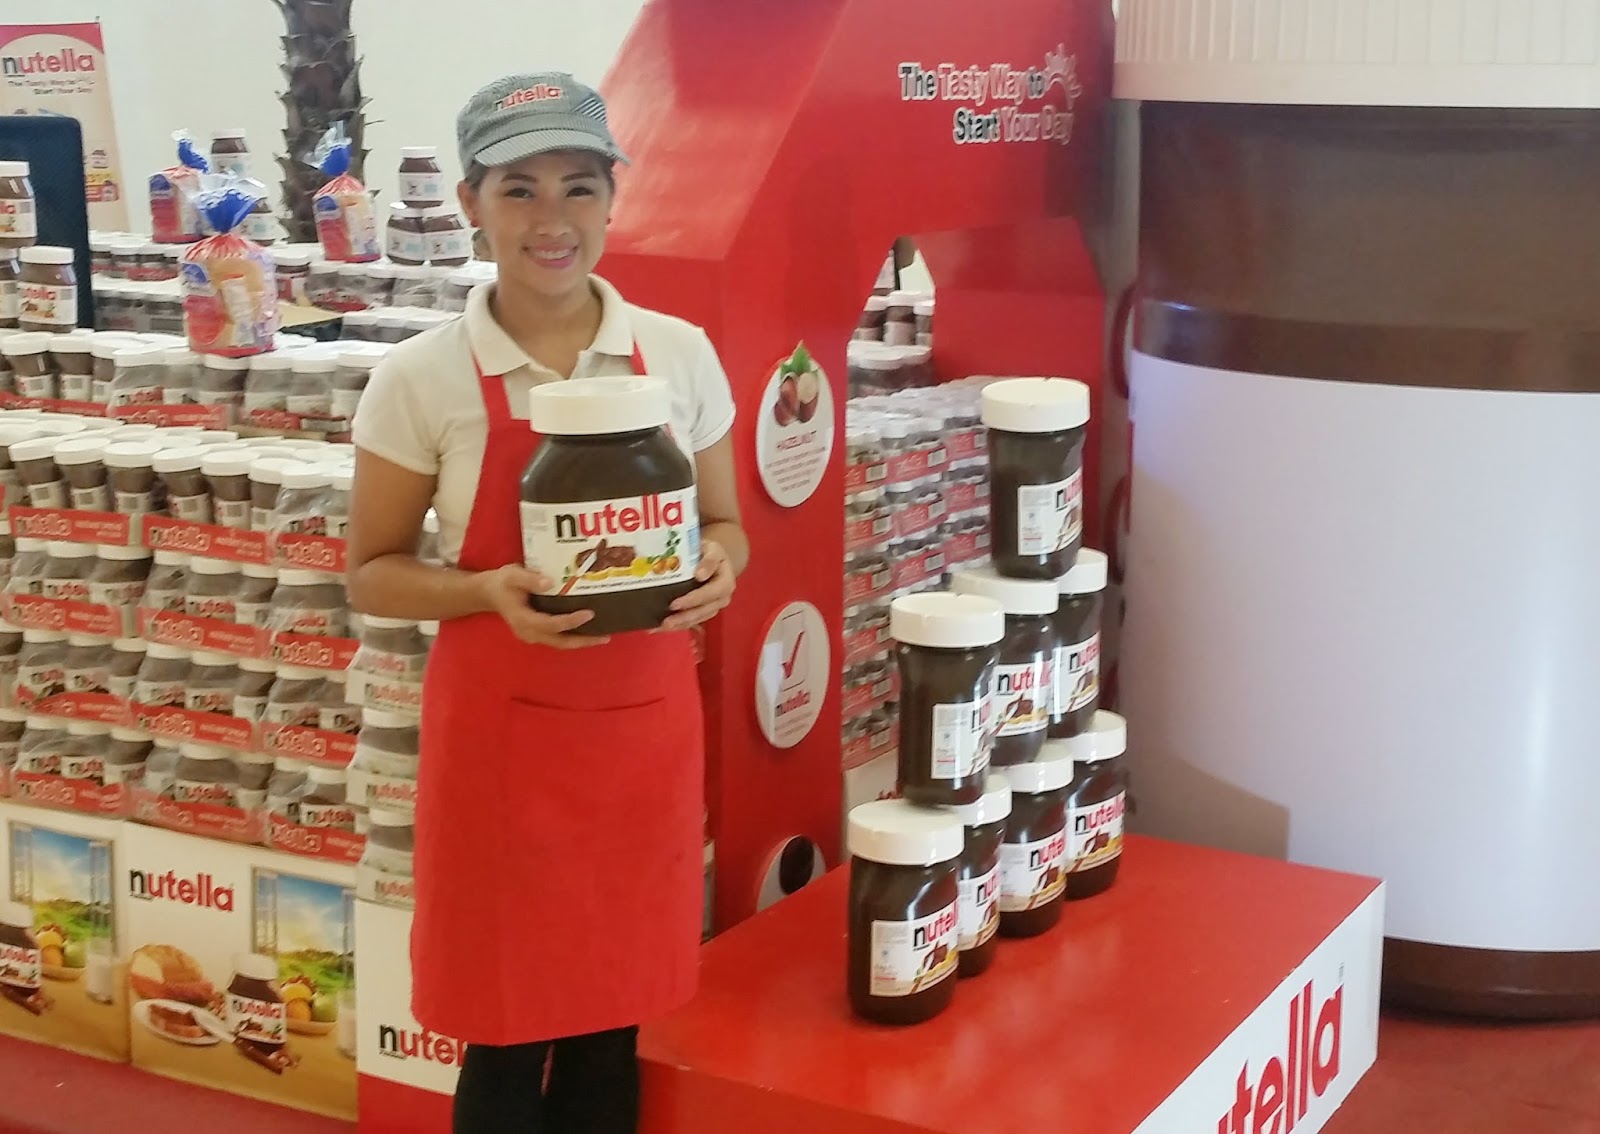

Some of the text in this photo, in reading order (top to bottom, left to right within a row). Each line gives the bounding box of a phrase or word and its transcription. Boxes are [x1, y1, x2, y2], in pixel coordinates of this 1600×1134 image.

[2, 48, 95, 74] nutella
[493, 84, 561, 111] nutella
[899, 62, 937, 100] The
[938, 63, 990, 106] Tasty
[990, 63, 1024, 105] Way
[953, 105, 1075, 145] Start Your Day
[556, 493, 683, 538] nutella
[130, 868, 235, 912] nutella
